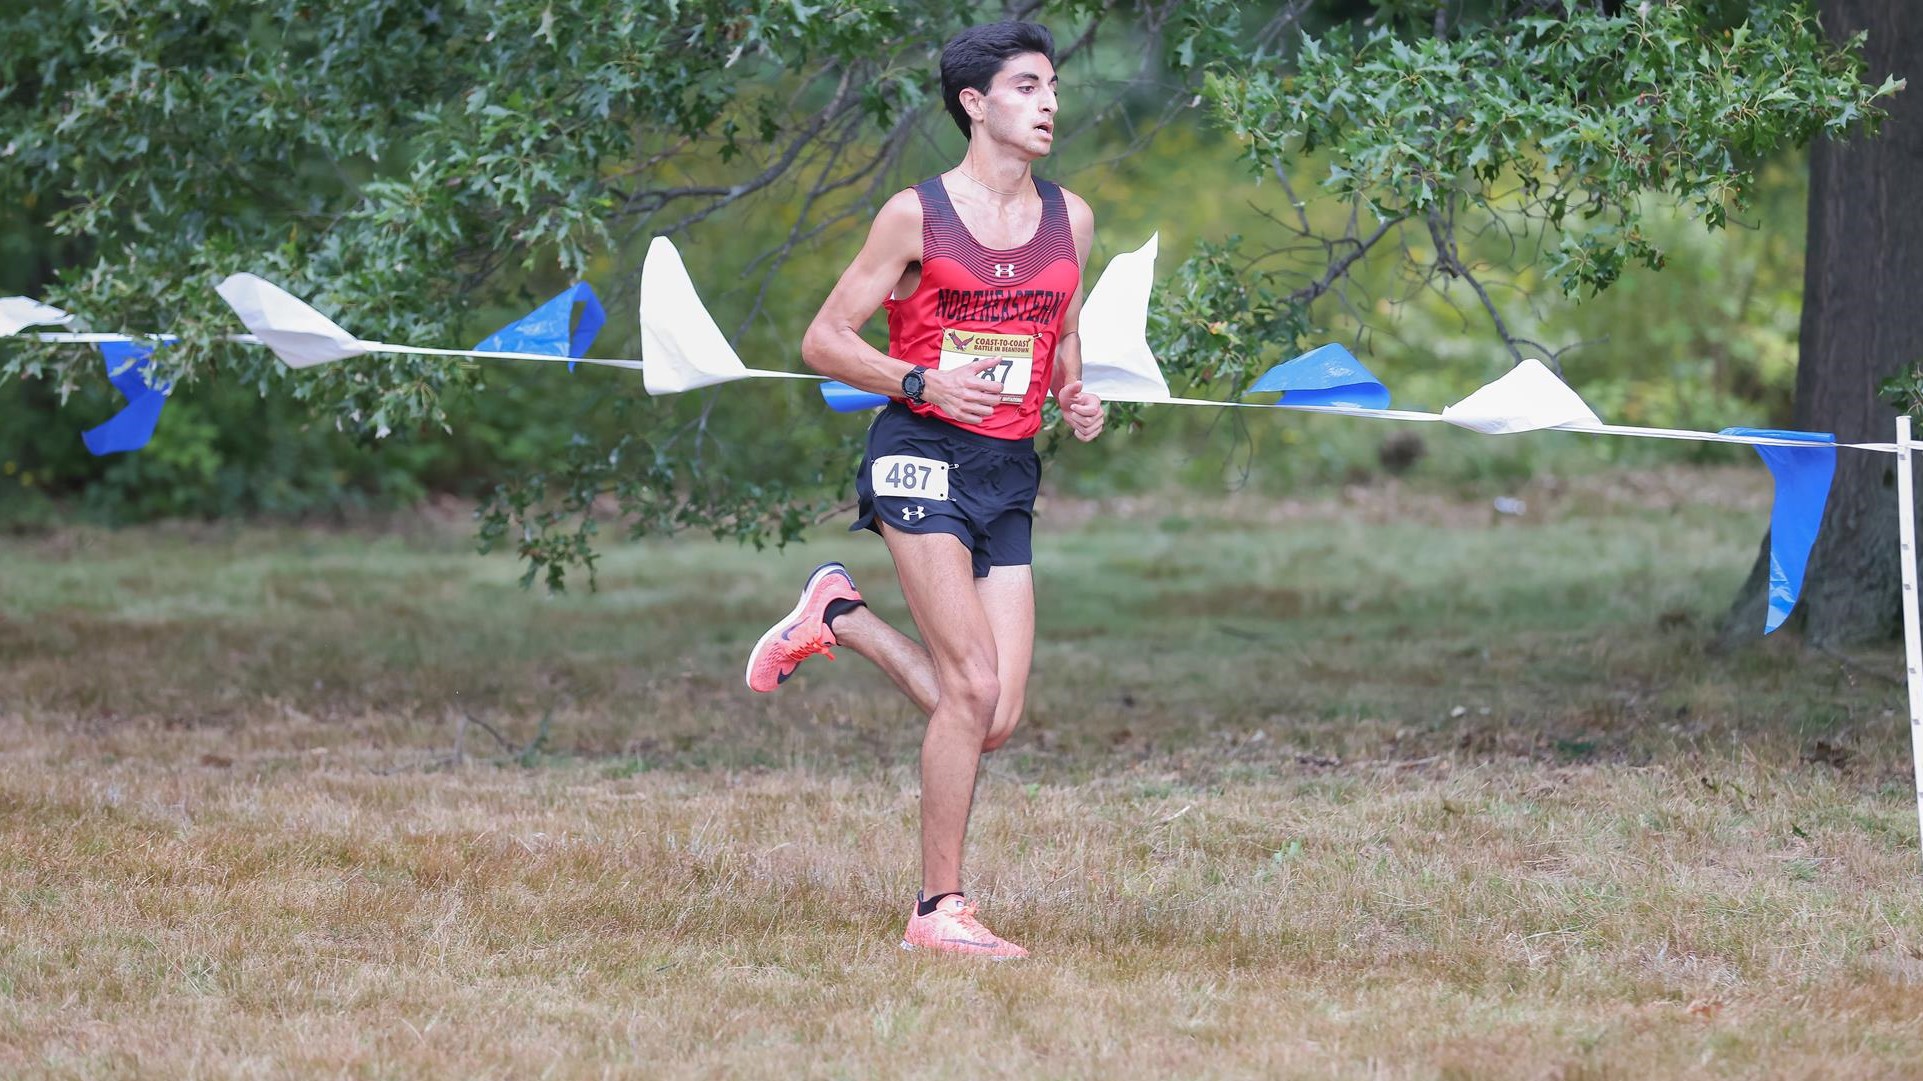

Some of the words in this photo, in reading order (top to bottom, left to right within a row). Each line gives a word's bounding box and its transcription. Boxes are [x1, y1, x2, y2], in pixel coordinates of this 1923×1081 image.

[935, 288, 1065, 324] NORTHEASTERN
[975, 337, 1031, 347] COAST-TO-COAST
[972, 357, 1014, 386] 87
[885, 462, 932, 491] 487
